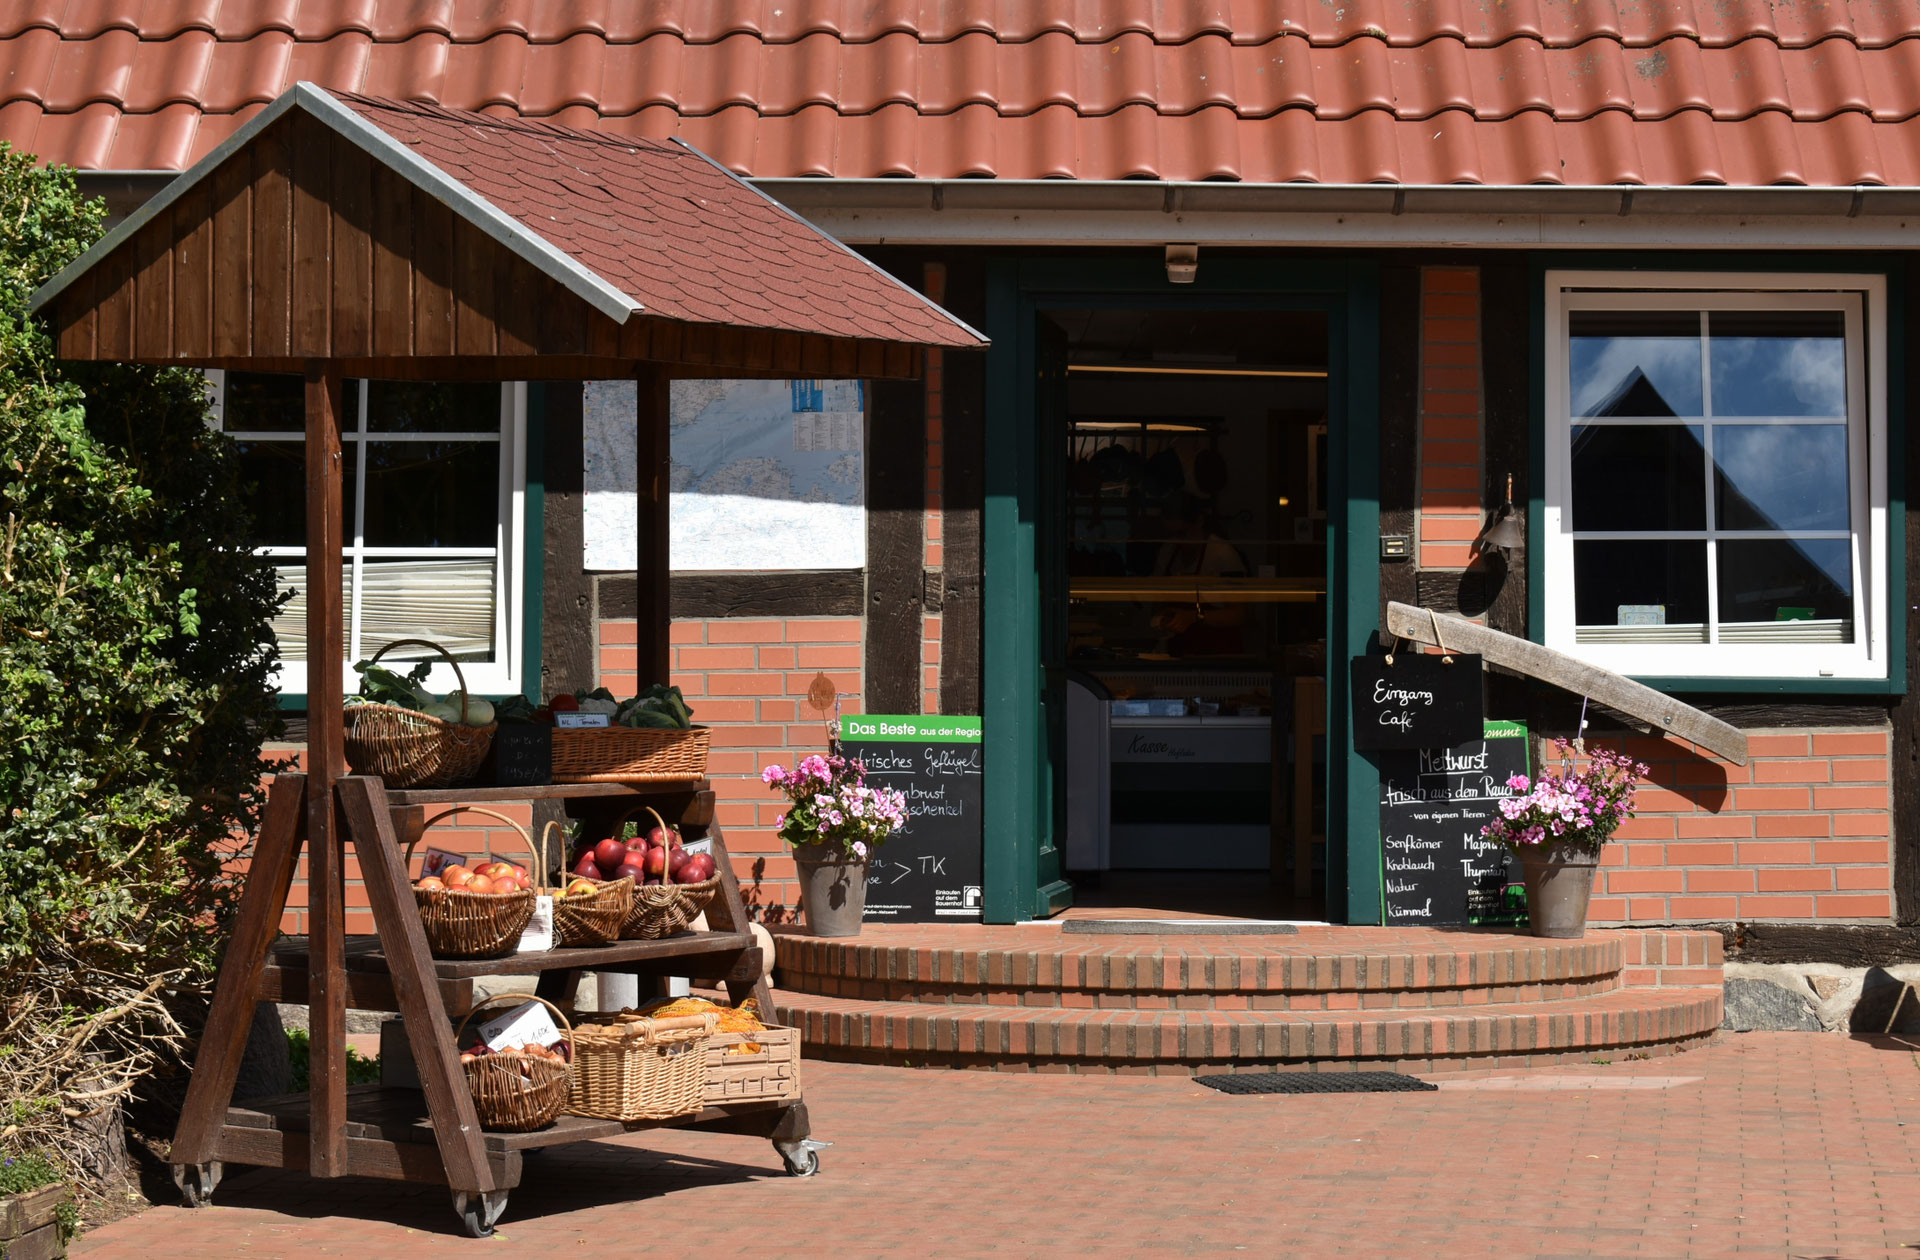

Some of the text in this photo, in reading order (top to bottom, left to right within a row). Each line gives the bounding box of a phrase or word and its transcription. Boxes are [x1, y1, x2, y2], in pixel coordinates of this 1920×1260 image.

[1373, 678, 1433, 706] Eingang
[849, 722, 982, 738] Das Beste aus der Regio
[1379, 709, 1417, 733] Café
[1483, 726, 1521, 738] ommt
[1128, 734, 1168, 754] Kasse
[859, 747, 981, 777] frisches Geflügel
[1419, 741, 1488, 773] Mettwurst
[1386, 775, 1426, 807] frisch
[1430, 787, 1451, 799] aus
[1455, 777, 1478, 799] dem
[1432, 810, 1459, 823] eigenen
[917, 855, 946, 876] TK
[1386, 855, 1435, 871] Knoblauch
[1460, 858, 1506, 886] Thymian
[1386, 878, 1418, 894] Natur
[1387, 898, 1432, 918] Kümmel
